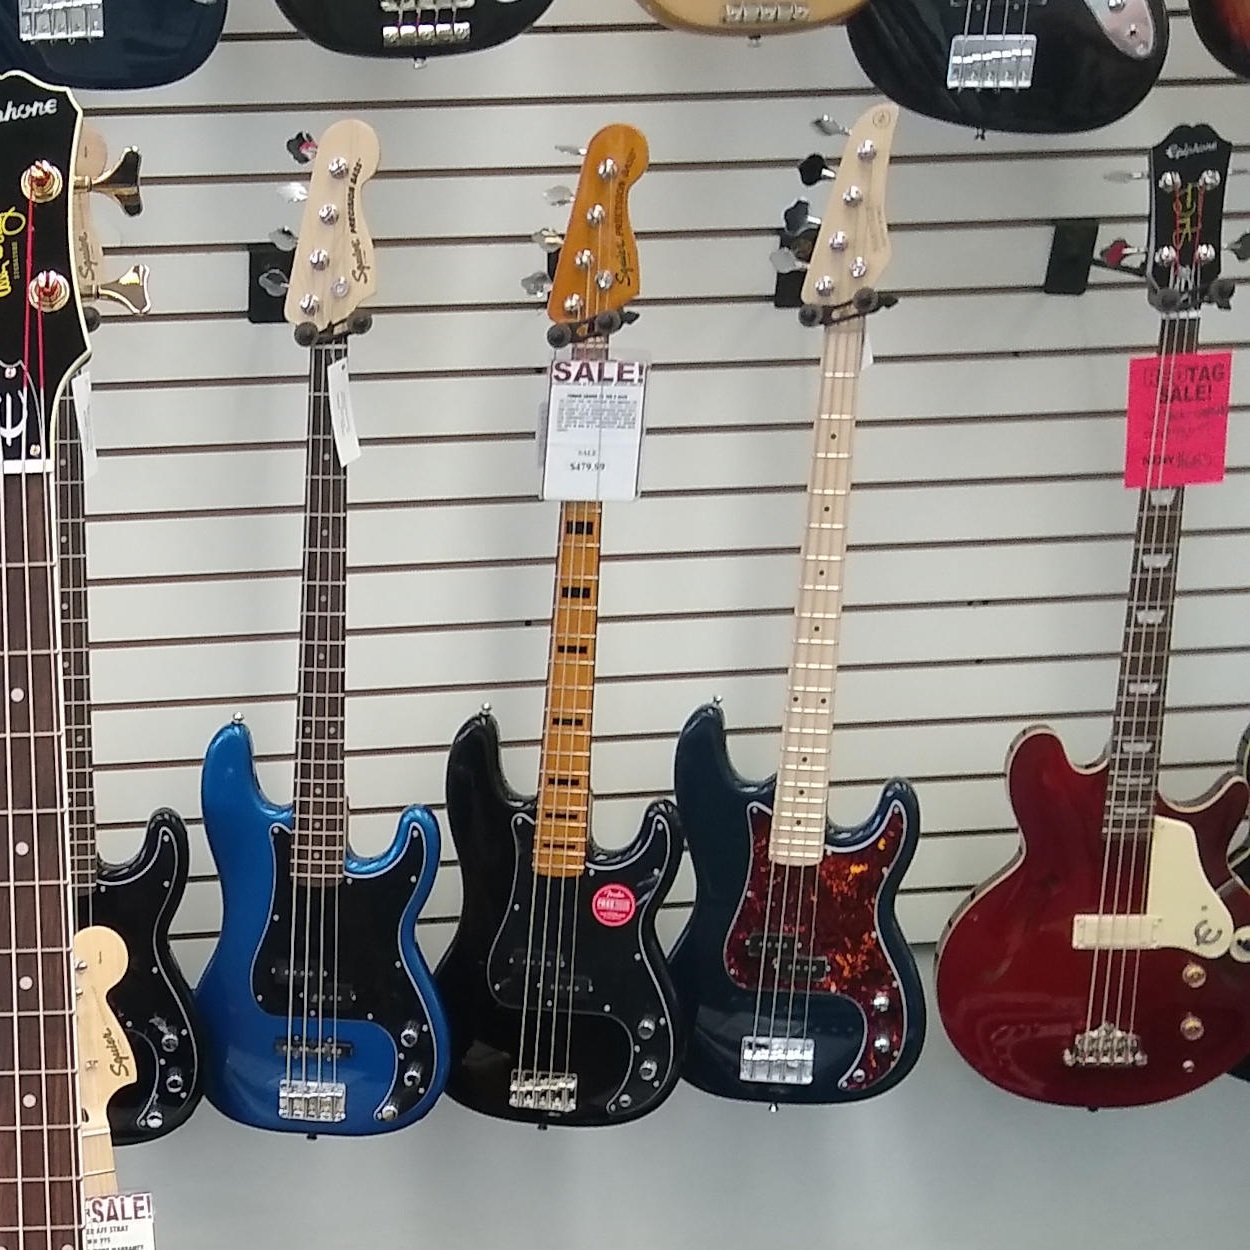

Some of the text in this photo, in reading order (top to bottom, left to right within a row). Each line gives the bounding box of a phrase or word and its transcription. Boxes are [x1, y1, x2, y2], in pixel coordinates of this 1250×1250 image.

[553, 361, 644, 384] SALE!
[1186, 363, 1225, 382] TAG
[1159, 384, 1213, 404] SALE!
[103, 1028, 129, 1077] Squier
[92, 1195, 152, 1223] SALE!
